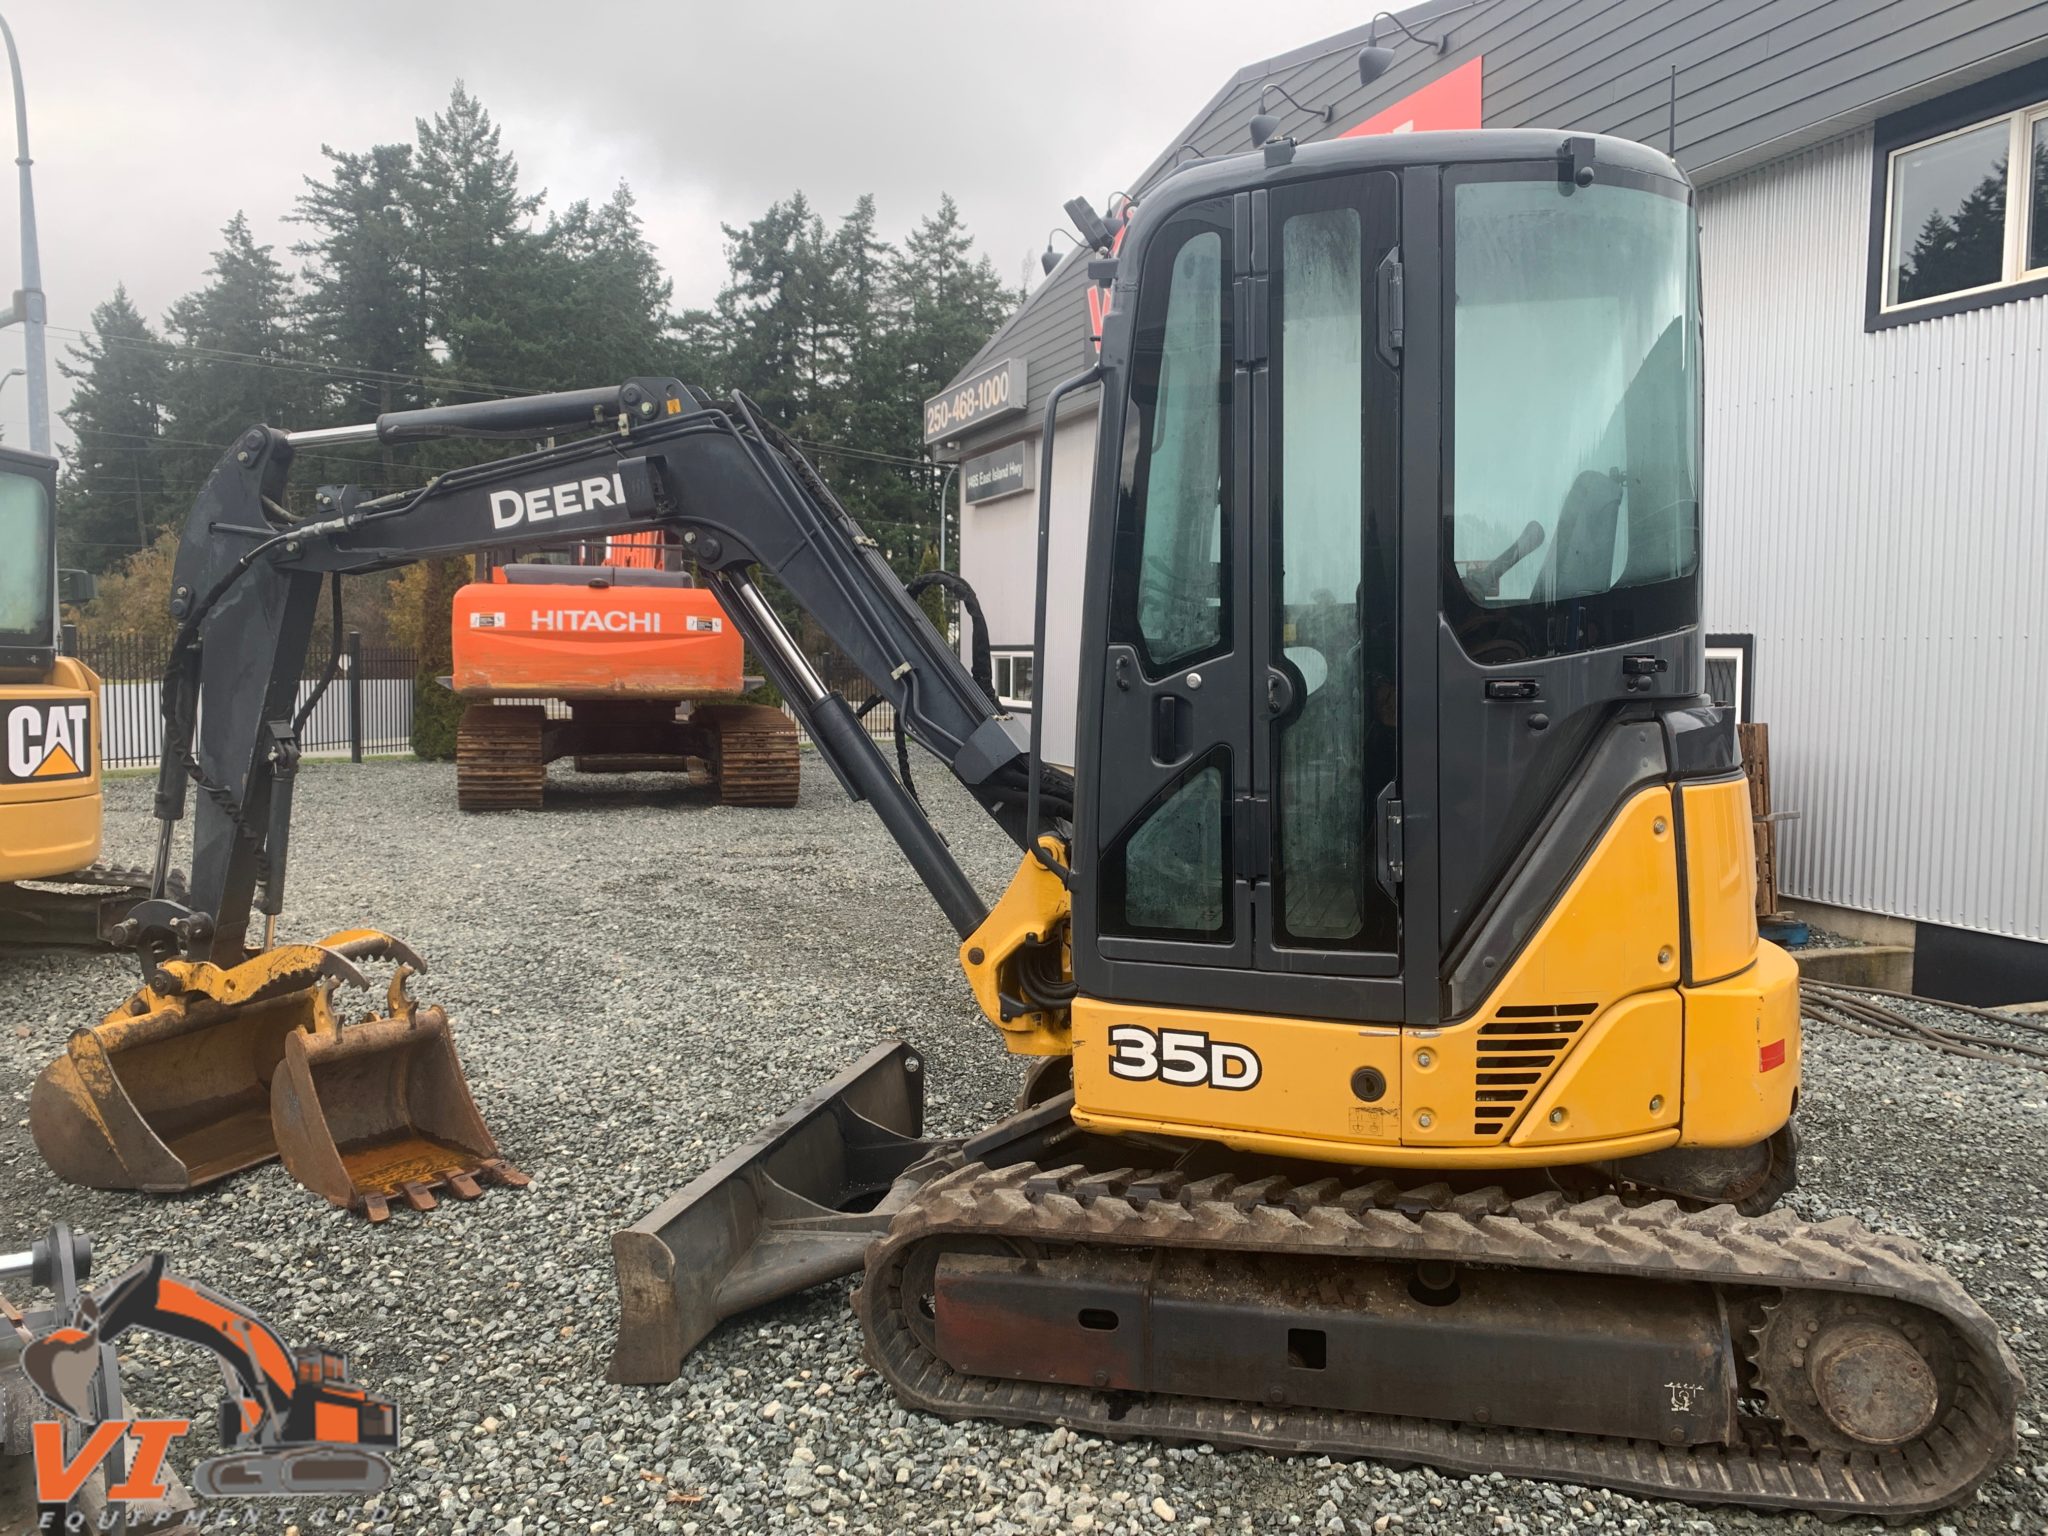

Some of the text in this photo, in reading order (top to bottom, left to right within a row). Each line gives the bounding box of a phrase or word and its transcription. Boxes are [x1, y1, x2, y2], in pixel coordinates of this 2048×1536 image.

[926, 371, 1009, 435] 250-468-1000
[979, 471, 991, 486] East
[991, 466, 1008, 481] Island
[1009, 461, 1022, 478] Hwy
[531, 610, 661, 633] HITACHI
[7, 704, 87, 778] CAT
[1108, 1024, 1263, 1092] 35D
